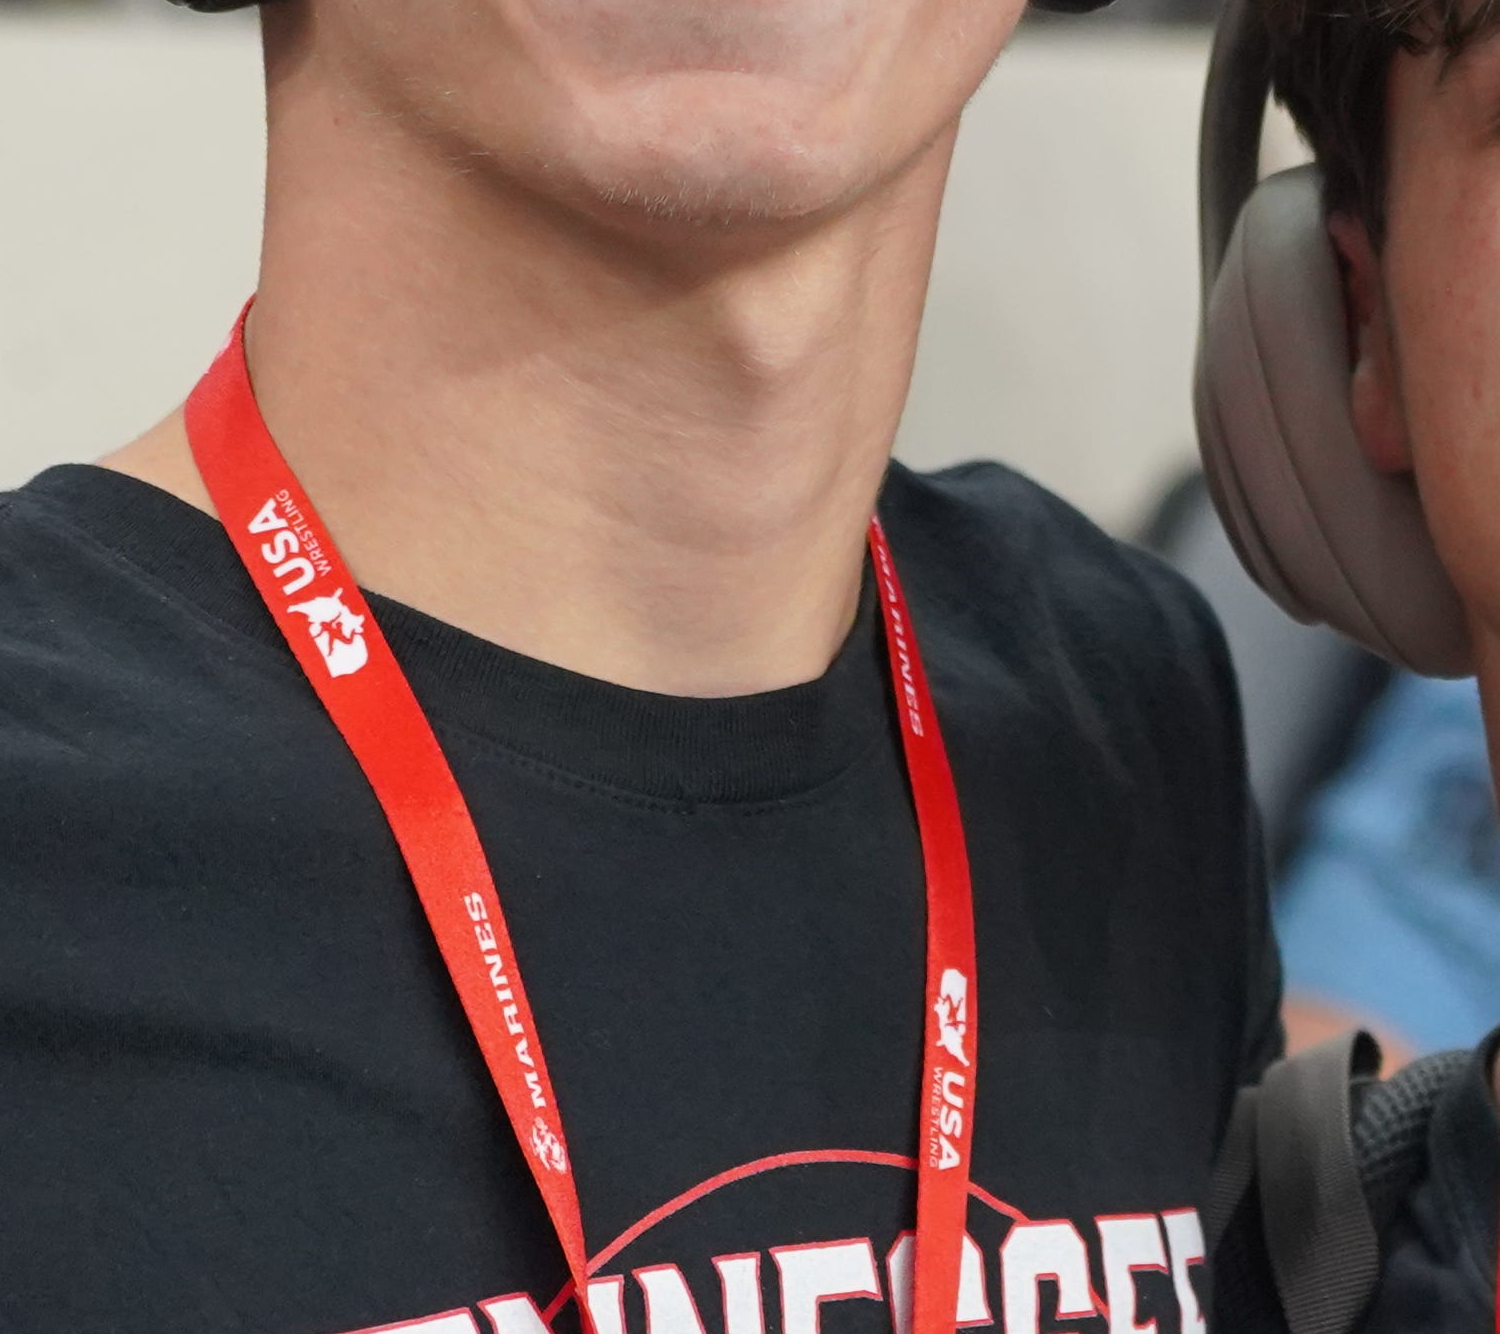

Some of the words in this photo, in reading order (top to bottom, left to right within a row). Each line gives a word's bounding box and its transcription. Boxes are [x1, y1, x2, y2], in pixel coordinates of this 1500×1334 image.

[247, 497, 316, 597] USA
[274, 488, 333, 578] WRESTLING
[464, 890, 547, 1109] MARINES
[928, 1067, 944, 1168] WRESTLING
[938, 1070, 966, 1170] USA
